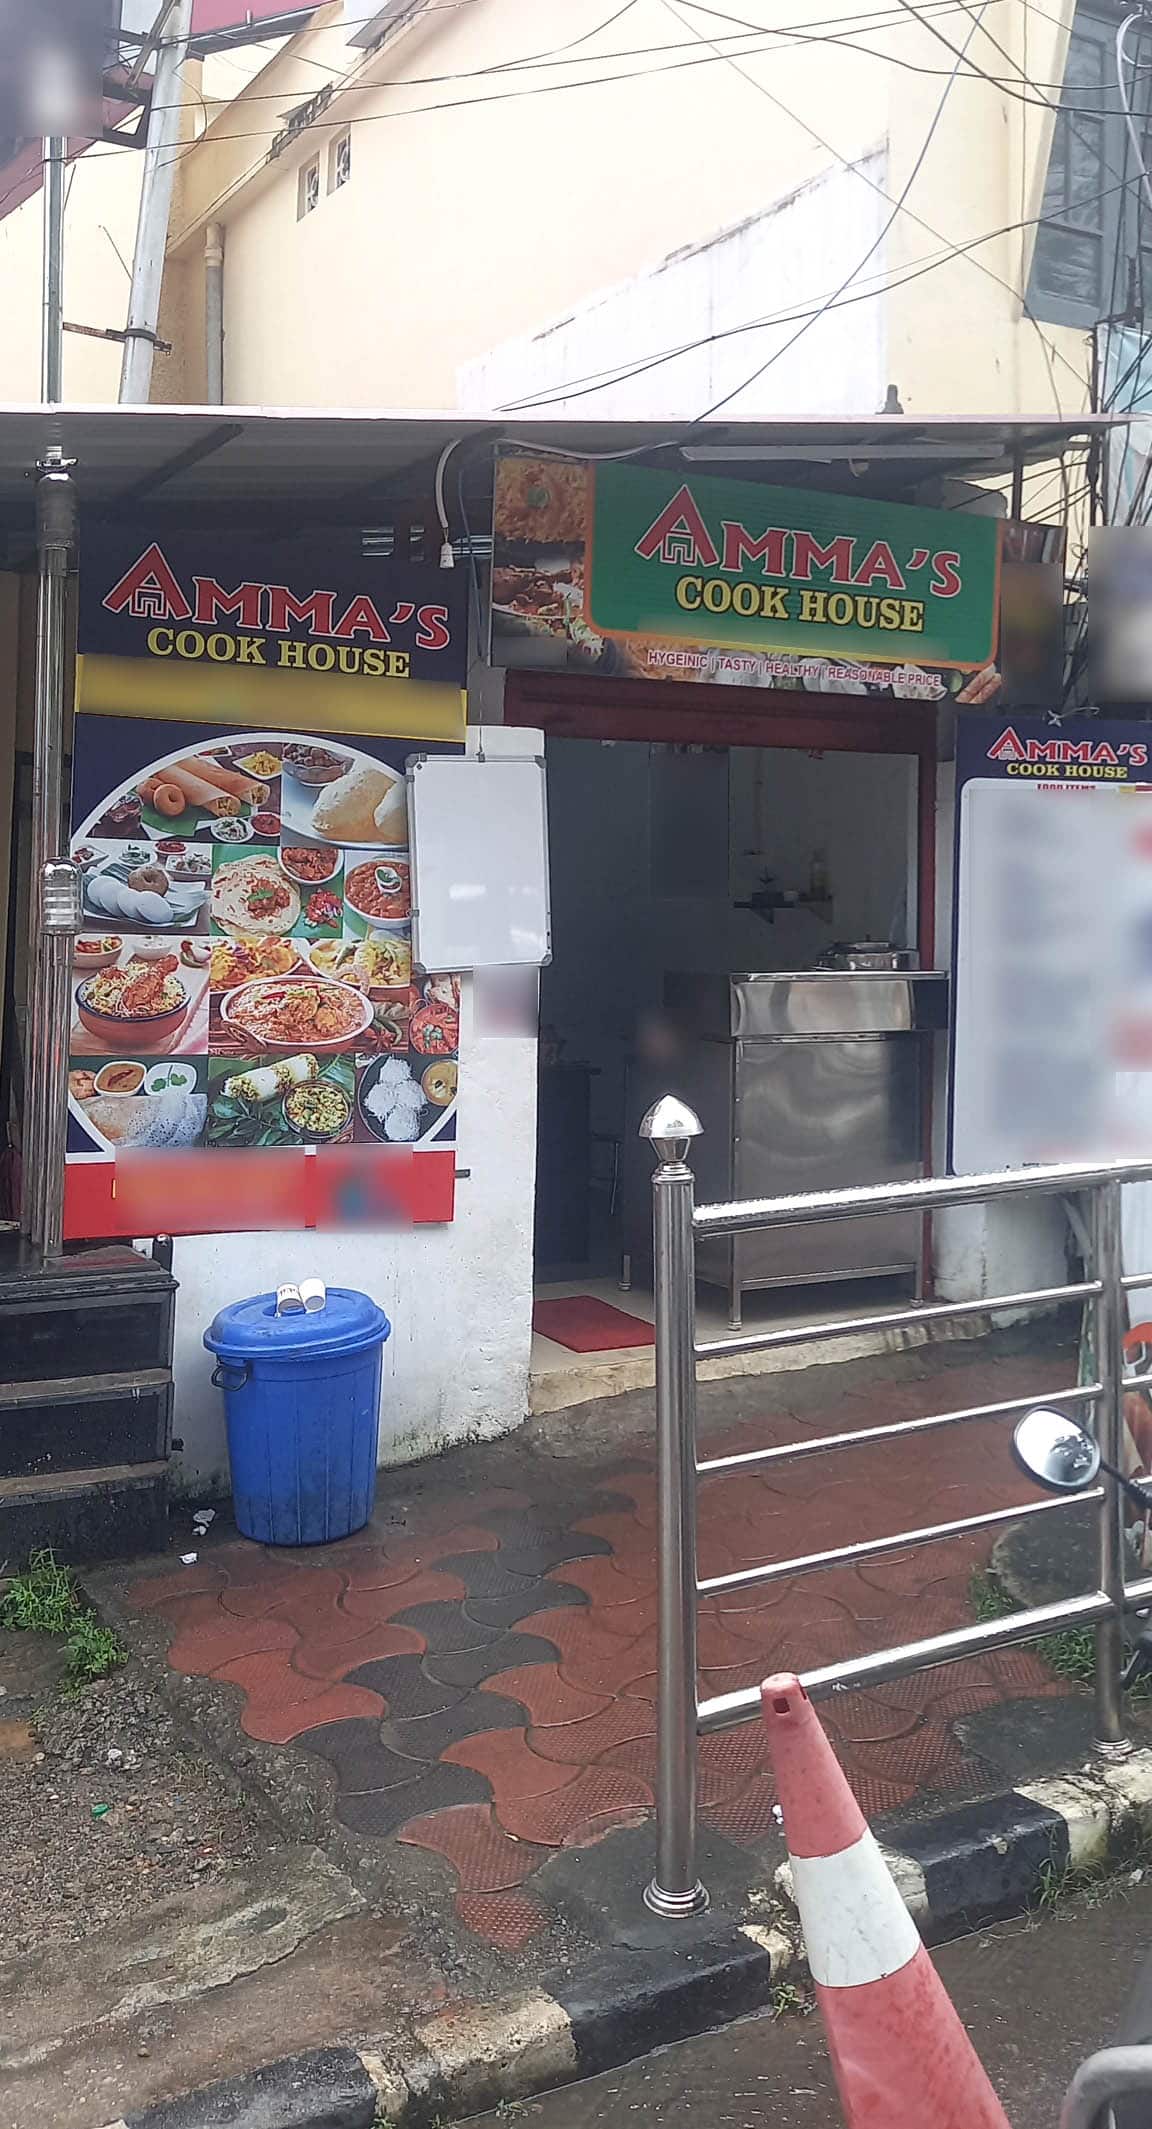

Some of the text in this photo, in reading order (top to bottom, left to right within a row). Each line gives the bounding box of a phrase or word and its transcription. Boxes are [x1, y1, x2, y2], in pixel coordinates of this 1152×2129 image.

[633, 483, 962, 598] AMMA'S
[102, 542, 452, 650] AMMA'S
[675, 576, 925, 633] COOK HOUSE
[146, 627, 412, 678] COOK HOUSE
[719, 656, 757, 672] TASTY
[765, 661, 819, 677] HEALTHY
[827, 667, 905, 684] REASONABLE
[907, 673, 941, 687] PRICE
[987, 726, 1148, 765] AMMA'S
[1006, 762, 1128, 778] COOK HOUSE
